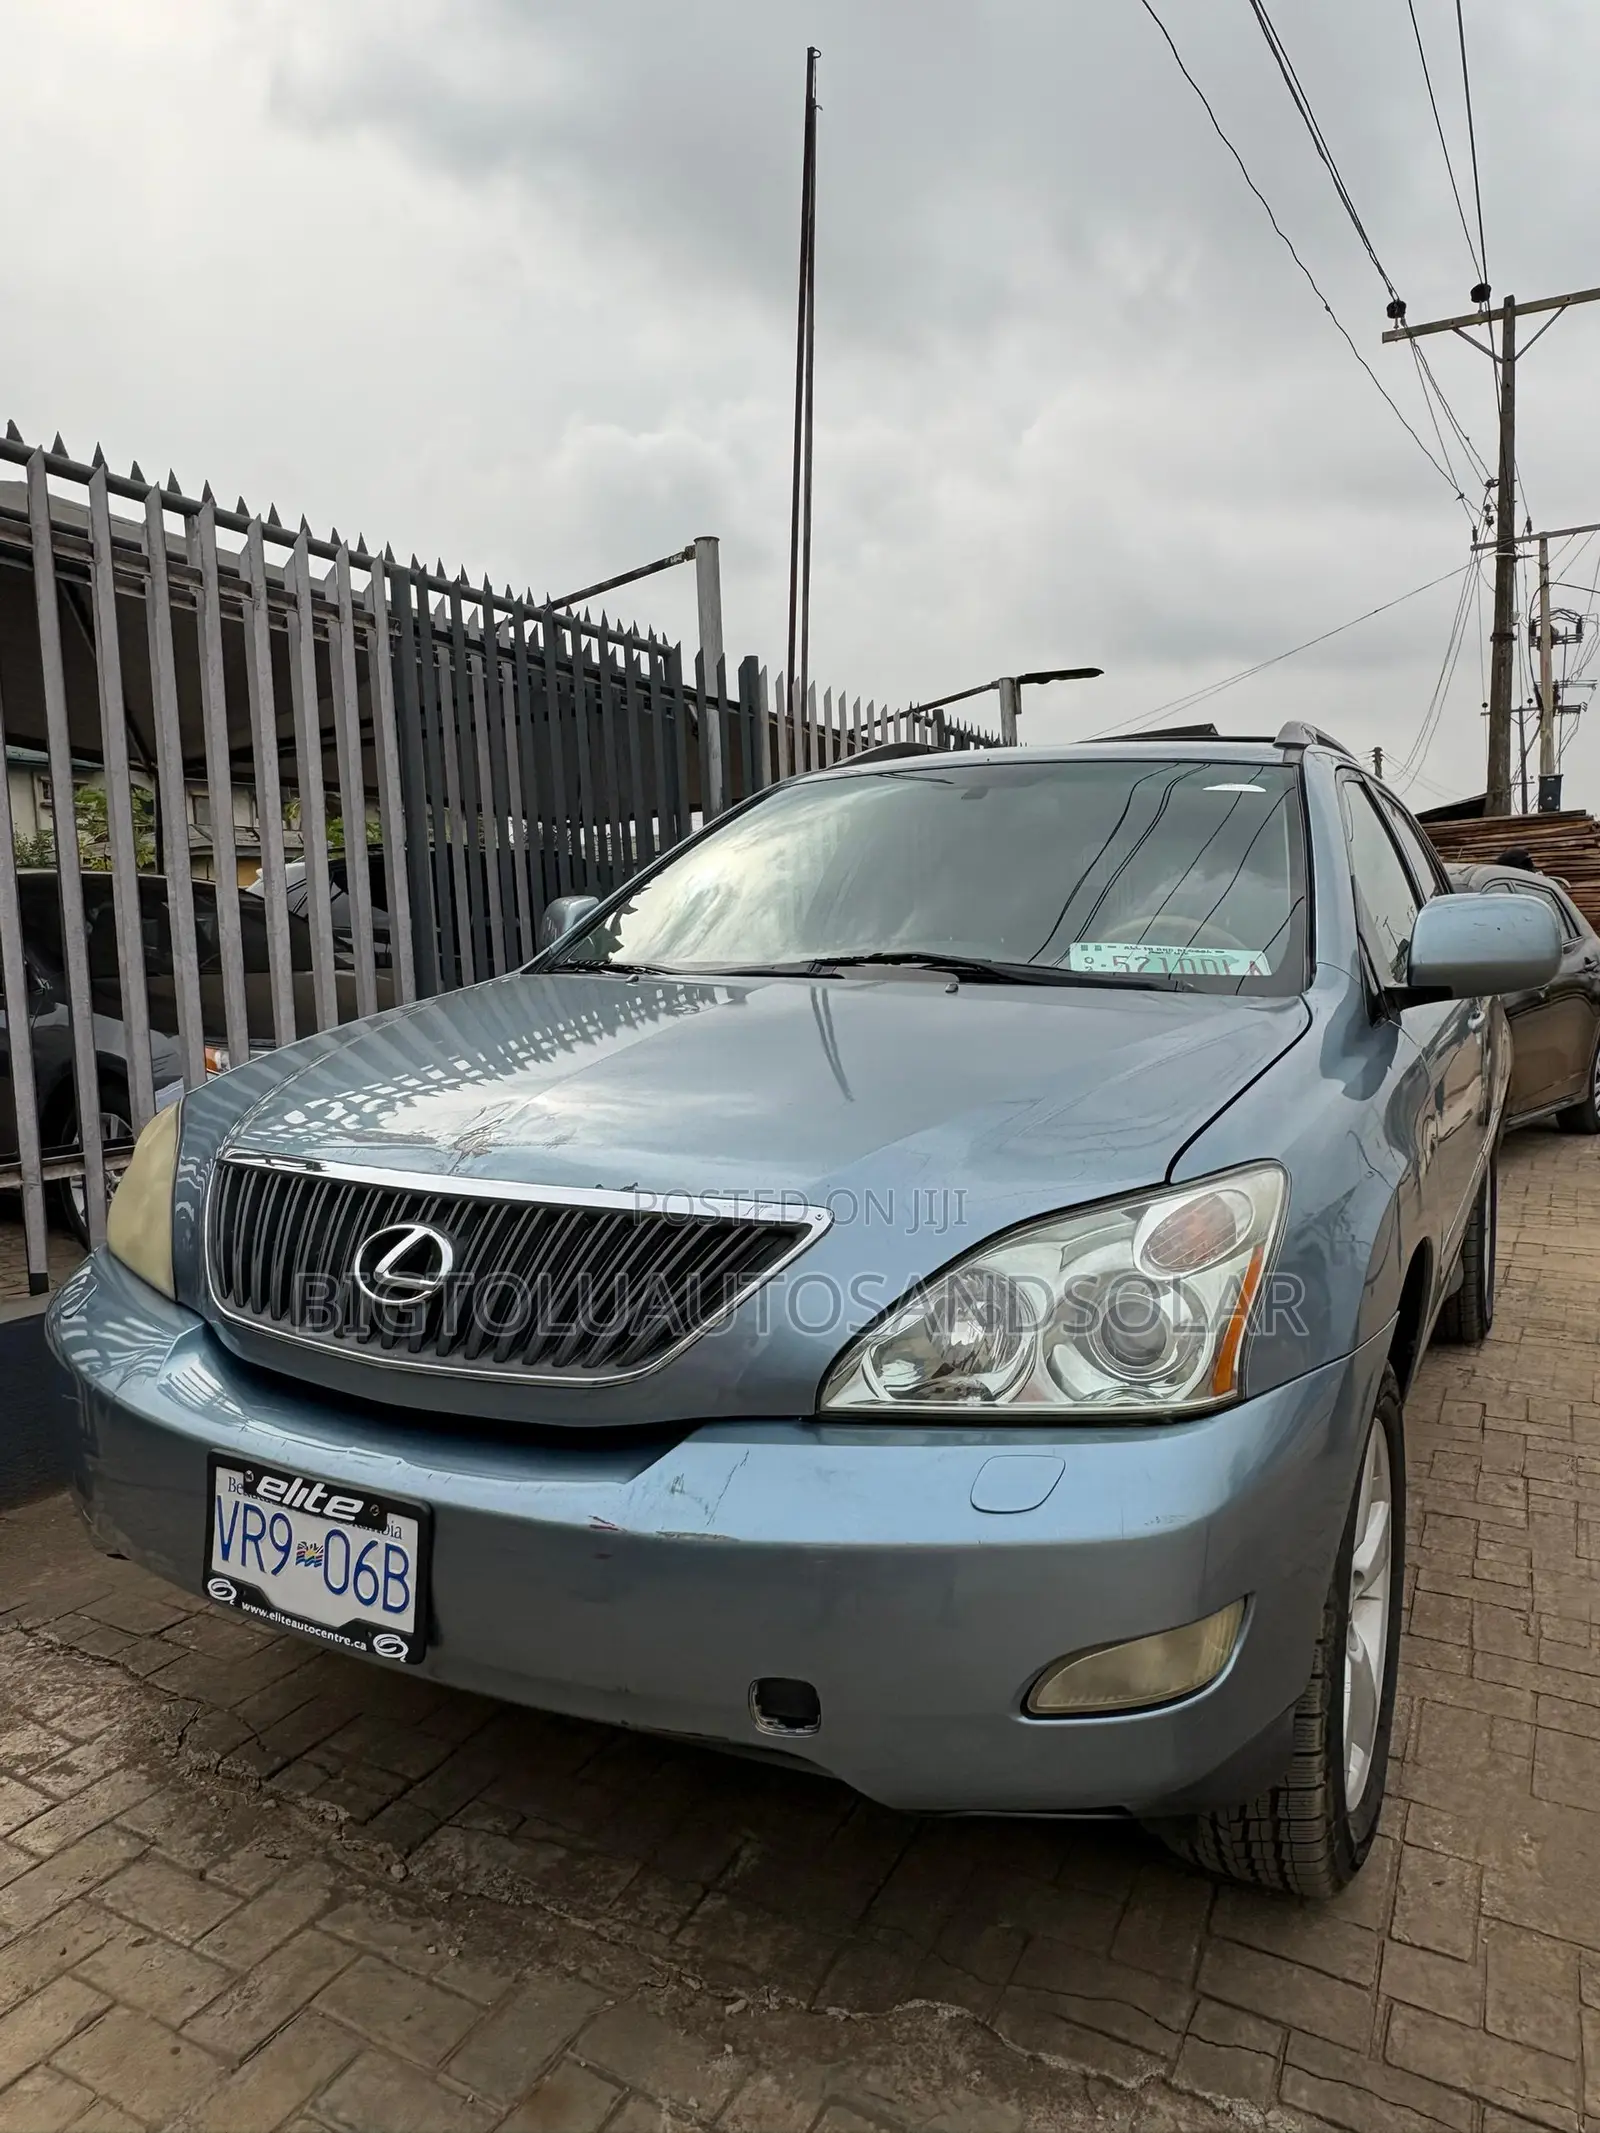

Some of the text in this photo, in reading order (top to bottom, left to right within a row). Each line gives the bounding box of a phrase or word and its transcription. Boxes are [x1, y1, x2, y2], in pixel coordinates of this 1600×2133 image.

[256, 1475, 365, 1521] elite
[216, 1494, 411, 1615] VR9 06B
[241, 1601, 368, 1652] www.eliteautocentre.ca
